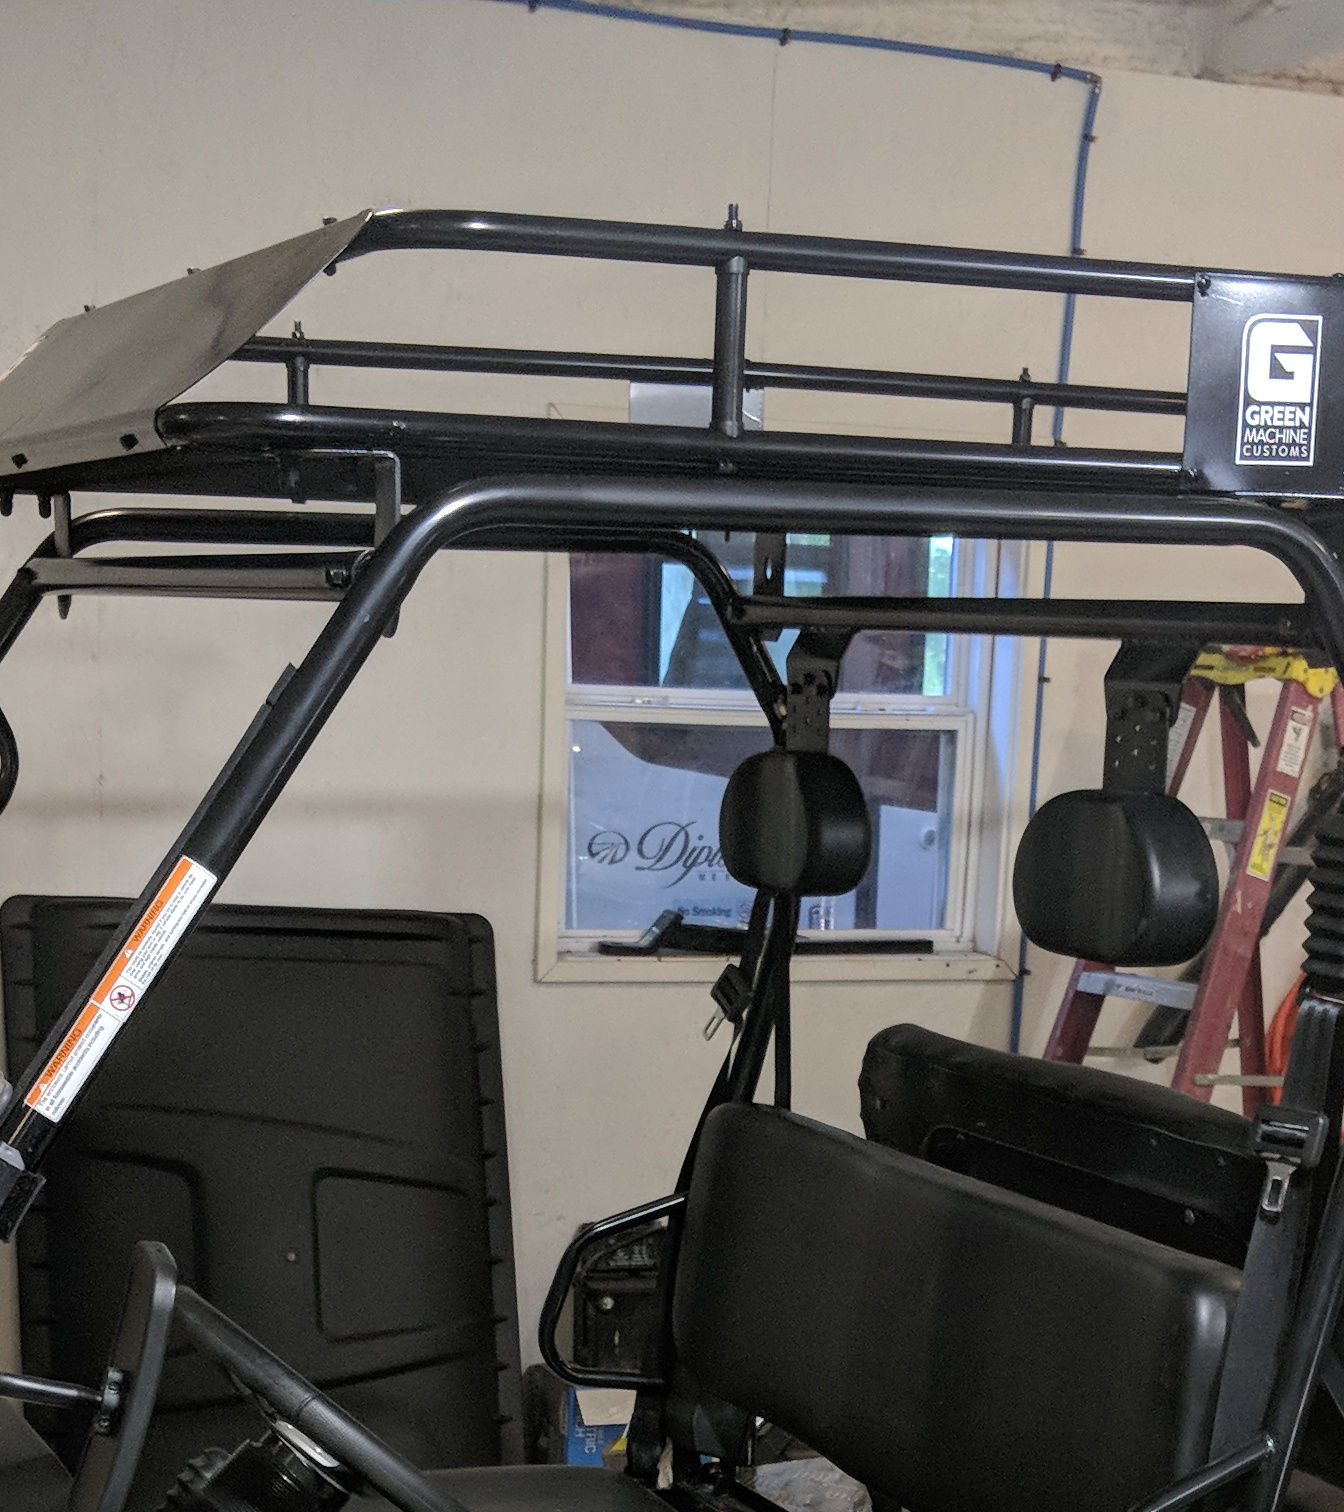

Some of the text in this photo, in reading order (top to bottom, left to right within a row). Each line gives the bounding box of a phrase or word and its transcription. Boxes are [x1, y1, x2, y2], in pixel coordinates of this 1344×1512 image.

[1245, 405, 1310, 426] GREEN
[1243, 428, 1308, 444] MACHINE
[1242, 445, 1308, 457] CUSTOMS
[45, 1026, 82, 1078] WARNING
